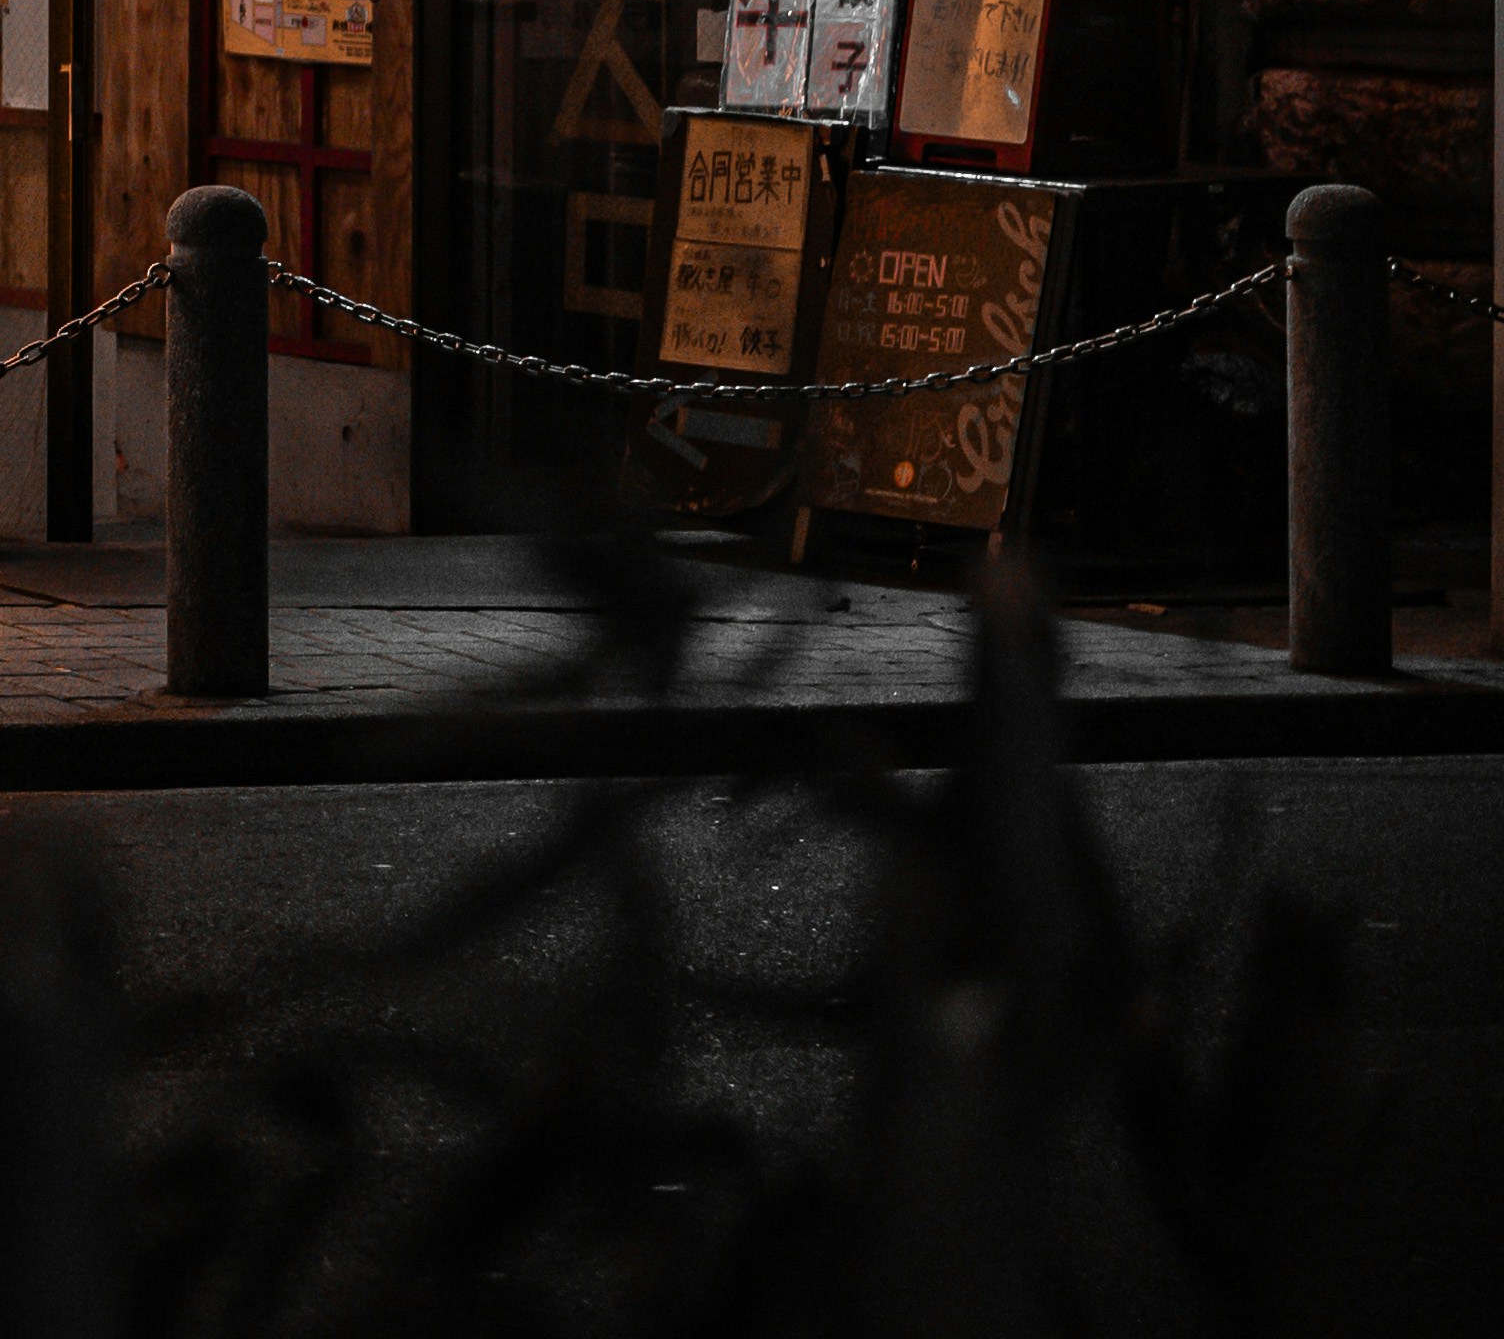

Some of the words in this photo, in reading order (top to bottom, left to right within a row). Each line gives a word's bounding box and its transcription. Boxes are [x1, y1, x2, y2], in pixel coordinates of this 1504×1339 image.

[688, 149, 802, 206] 合同営業中
[878, 250, 949, 288] OPEN
